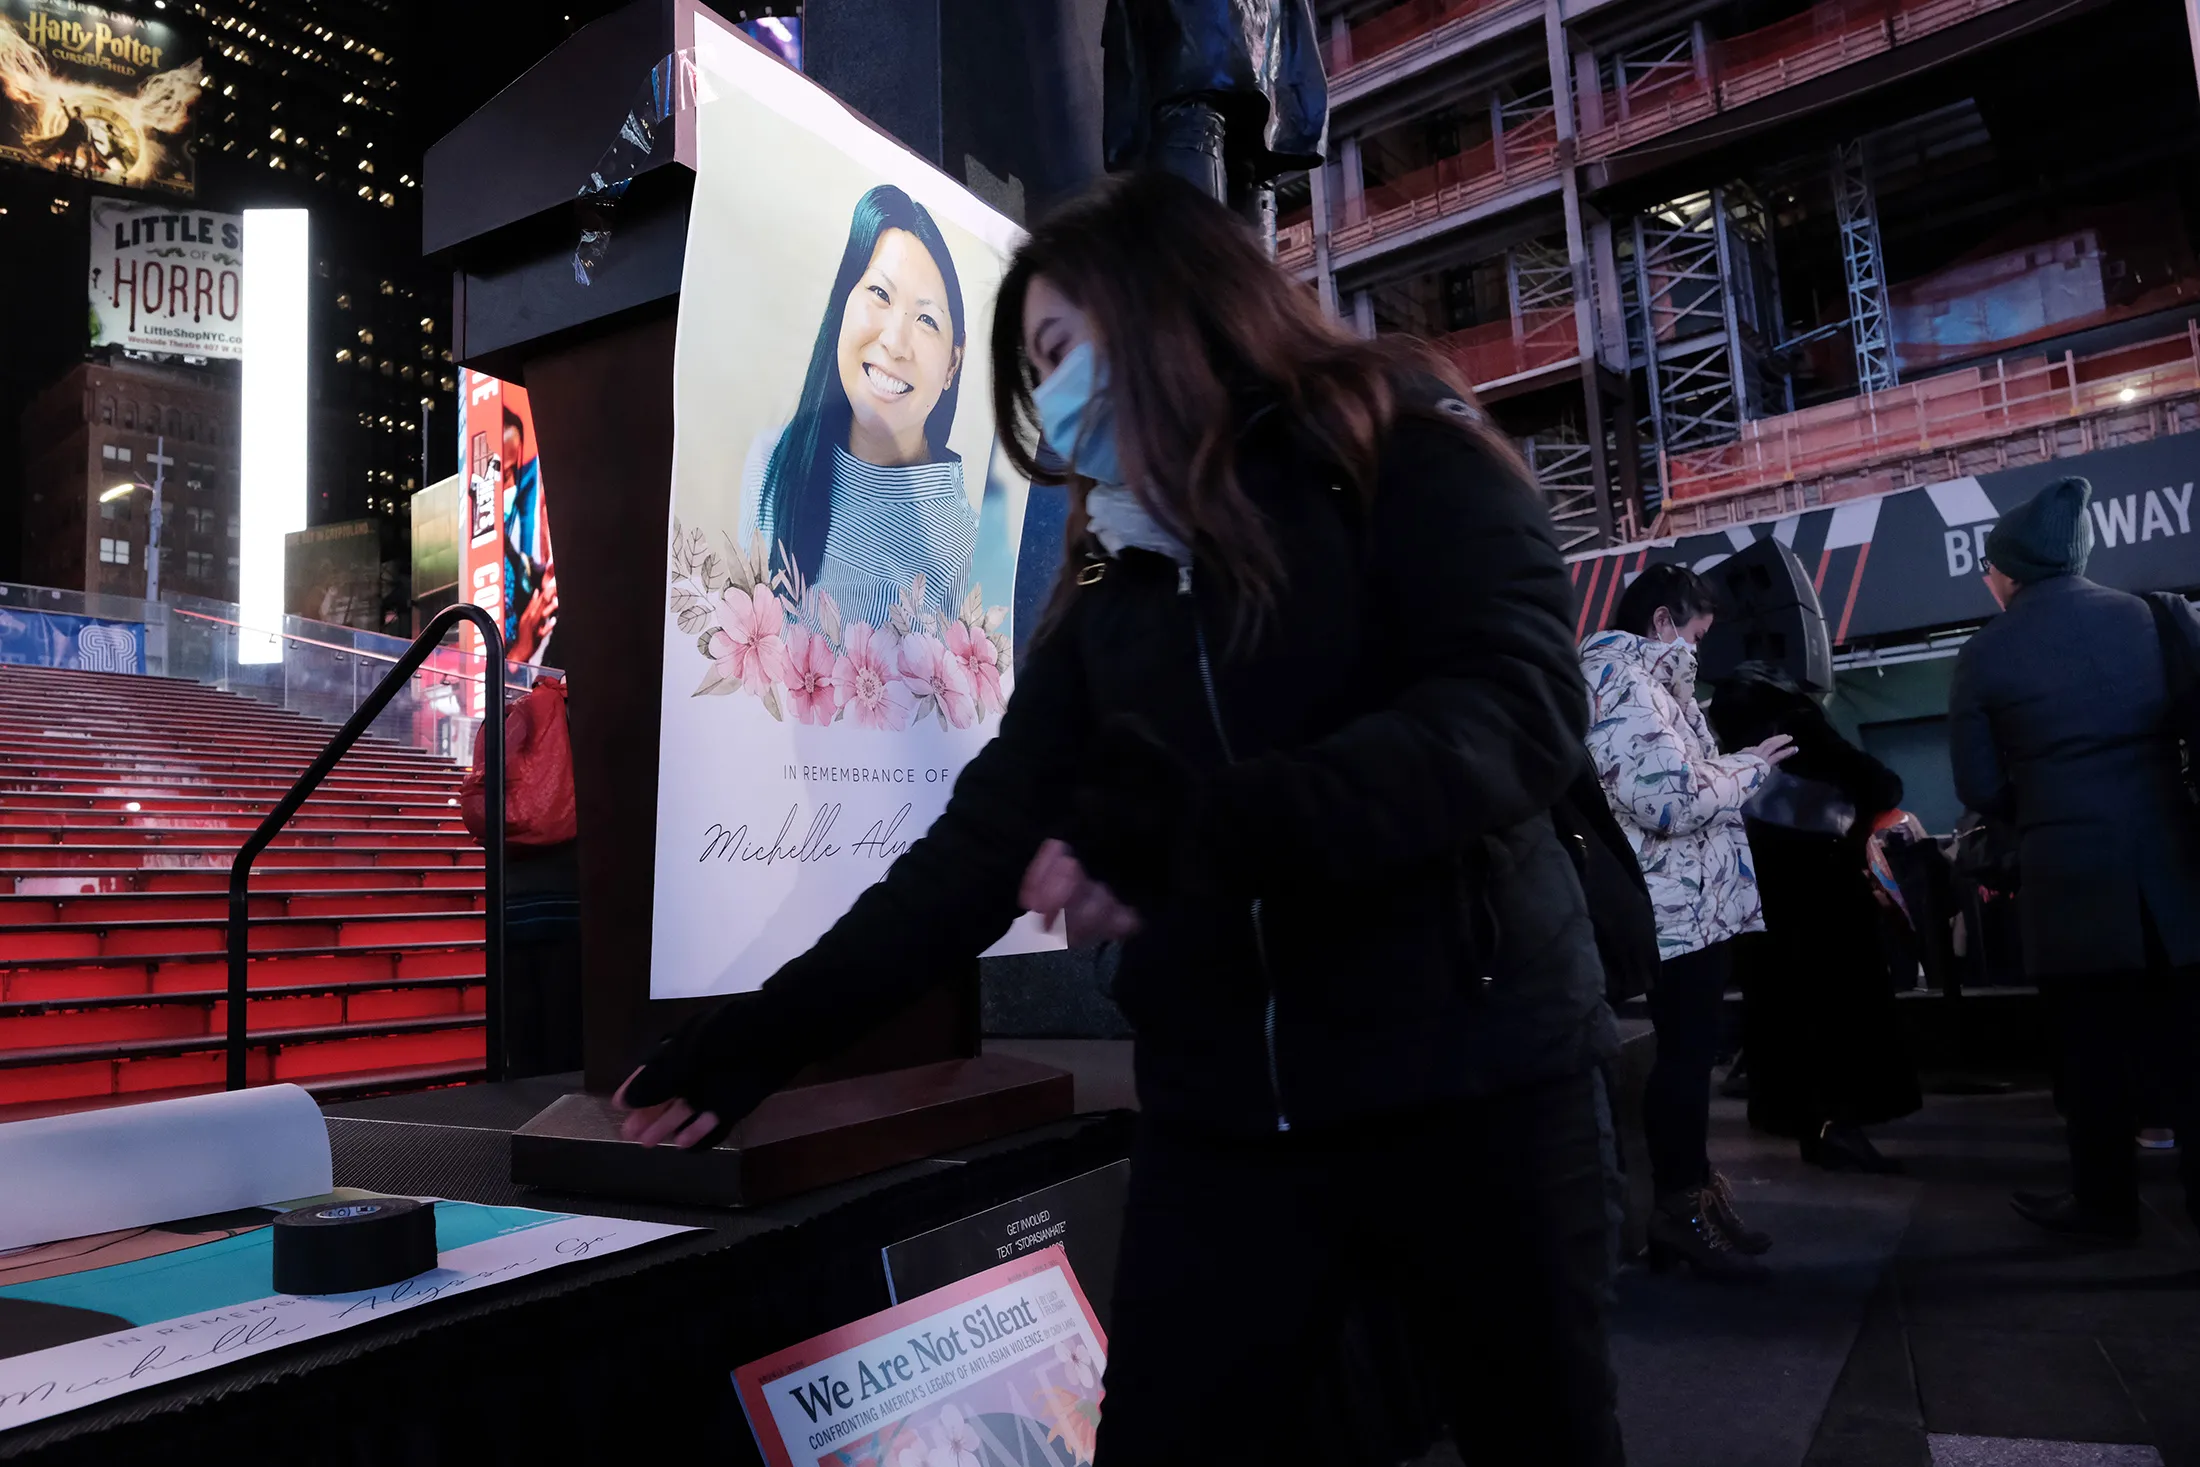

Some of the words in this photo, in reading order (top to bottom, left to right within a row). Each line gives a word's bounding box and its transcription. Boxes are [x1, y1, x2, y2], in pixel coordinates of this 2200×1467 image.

[24, 11, 94, 50] Harry
[95, 22, 163, 68] Potter
[115, 215, 214, 250] LITTLE
[190, 251, 209, 261] OF
[113, 258, 239, 332] HORRO
[144, 325, 242, 344] LittleShopNYC.co
[783, 764, 797, 780] IN
[803, 765, 915, 783] REMEMBRANCE
[925, 768, 949, 783] OF
[700, 802, 842, 866] Michelle
[852, 803, 912, 884] Aly
[1006, 1220, 1020, 1236] GET
[1020, 1210, 1051, 1231] INVOLVED
[996, 1242, 1013, 1259] TEXT
[0, 1316, 307, 1408] Michelle
[329, 1258, 537, 1318] Alyssa
[101, 1335, 142, 1348] IN
[788, 1375, 854, 1424] We
[858, 1352, 914, 1401] Are
[907, 1326, 968, 1374] Not
[962, 1296, 1038, 1350] Silent
[808, 1407, 879, 1450] CONFRONTING
[879, 1384, 927, 1417] AMERICA'S
[925, 1371, 956, 1397] LEGACY
[956, 1365, 968, 1380] OF
[969, 1345, 1011, 1375] ANTI-ASIAN
[1009, 1330, 1044, 1355] VIOLENCE
